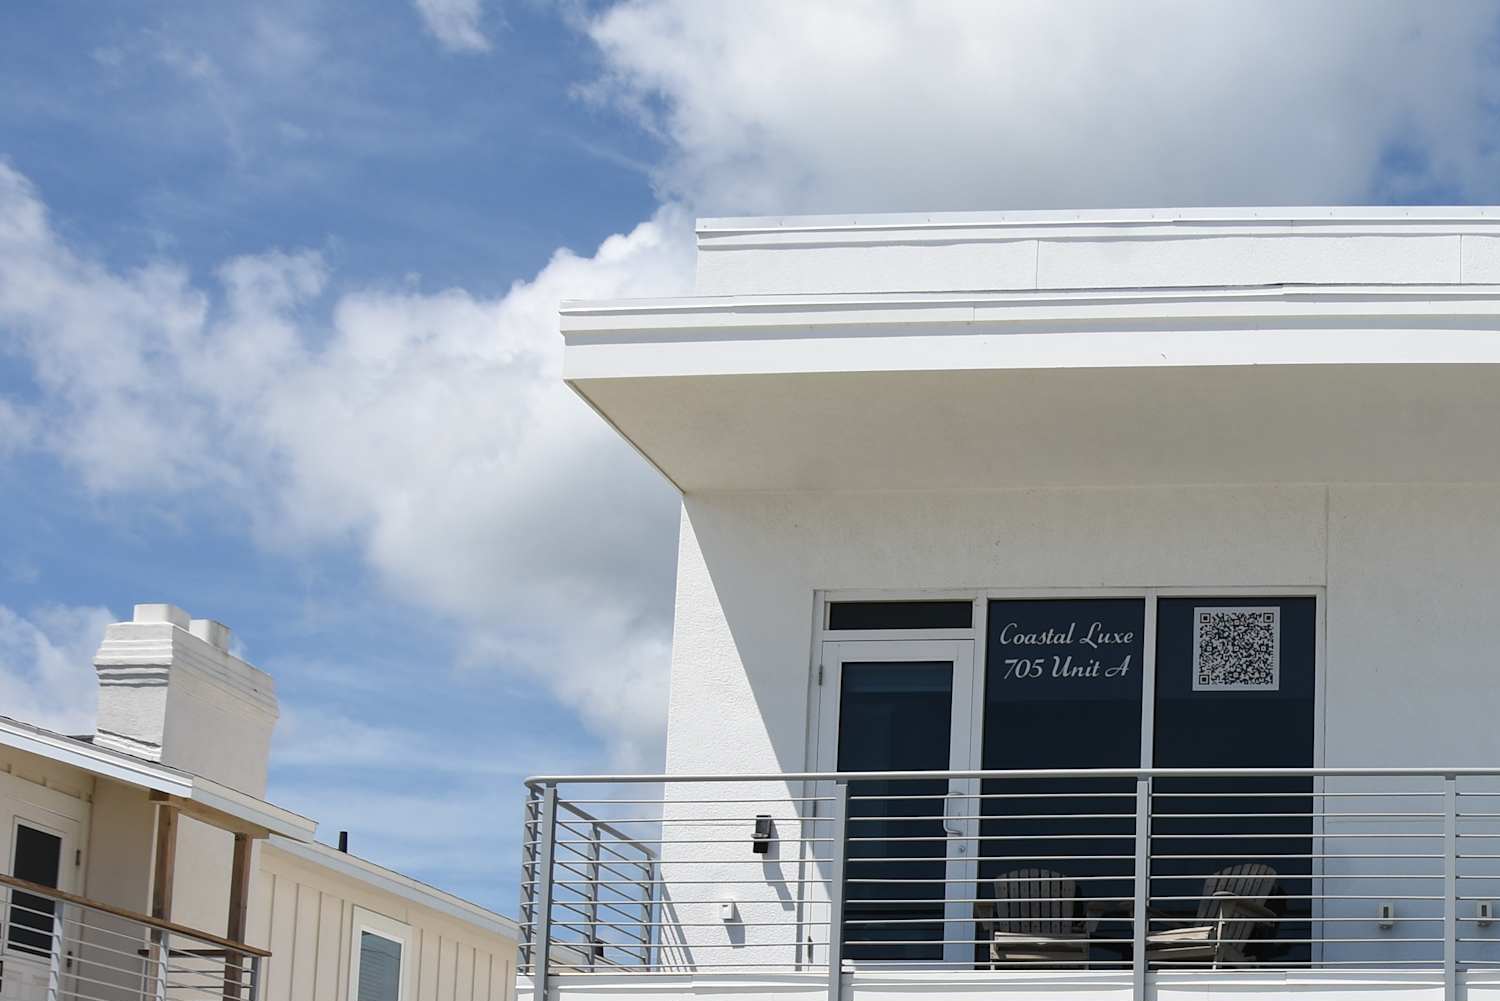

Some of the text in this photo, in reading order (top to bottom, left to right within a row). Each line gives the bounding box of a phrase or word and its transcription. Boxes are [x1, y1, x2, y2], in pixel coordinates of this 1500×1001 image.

[1000, 621, 1133, 648] Coastal Luxe
[1003, 655, 1131, 679] 705 Unit A
